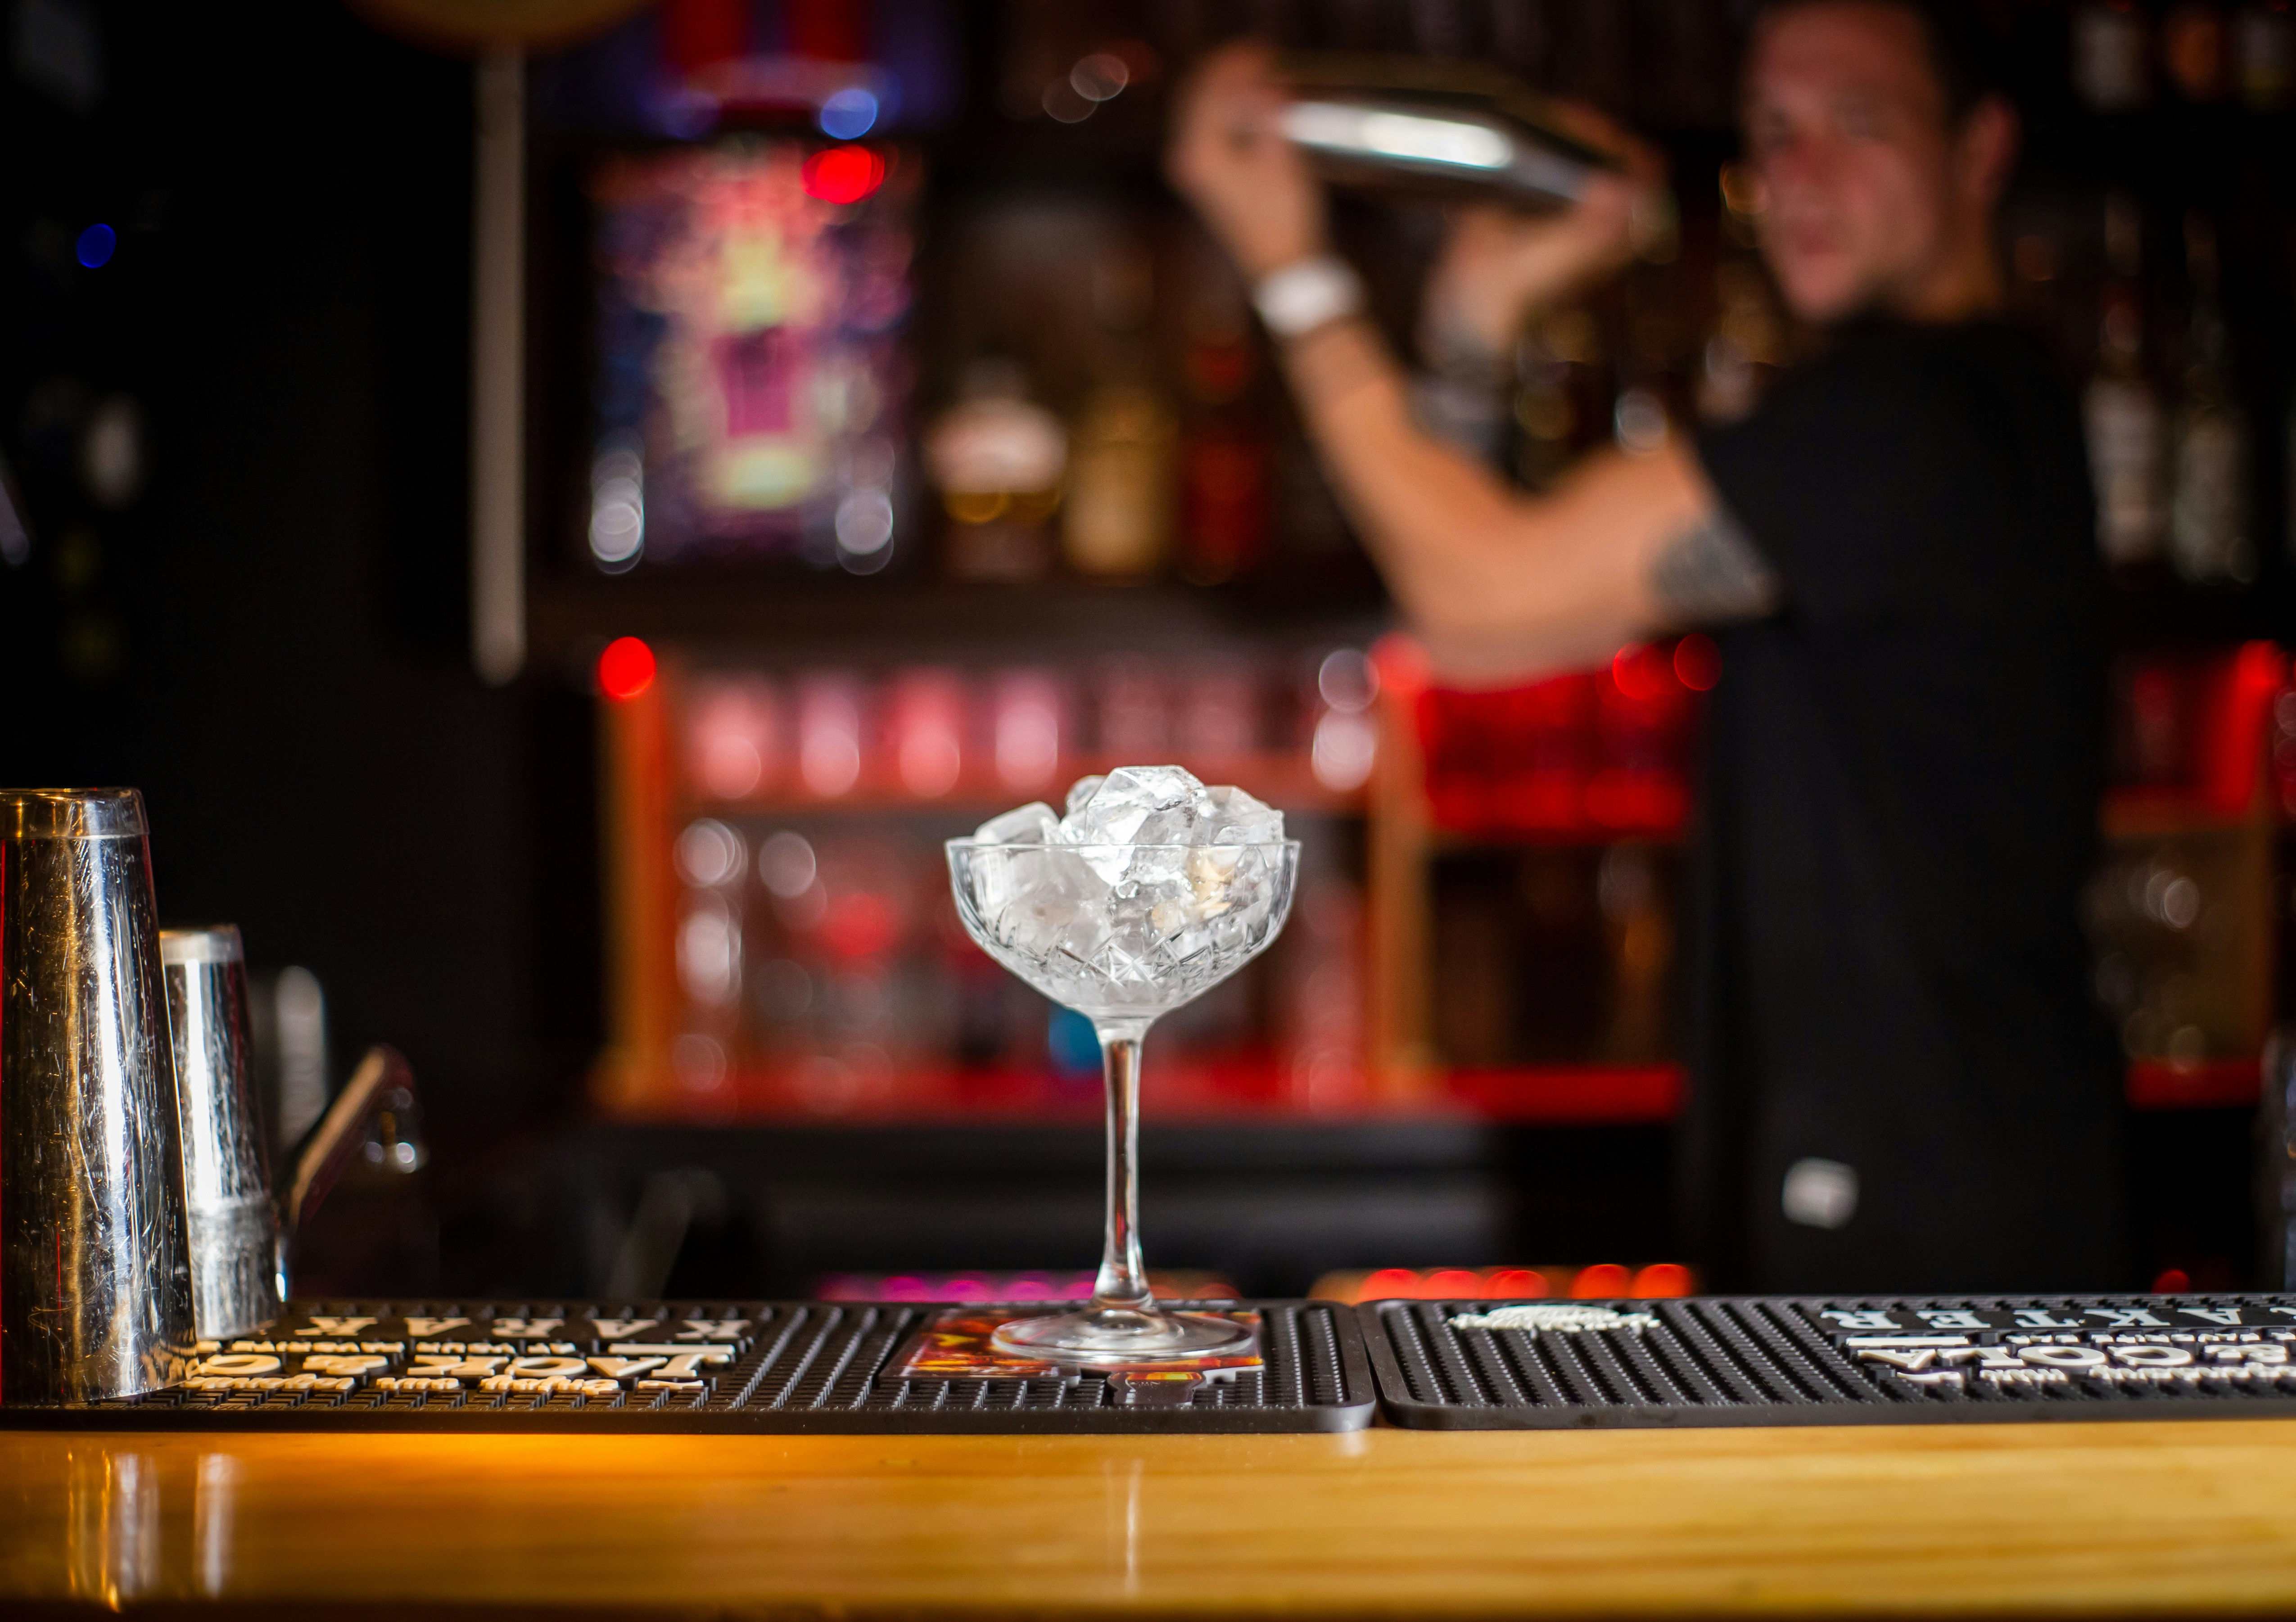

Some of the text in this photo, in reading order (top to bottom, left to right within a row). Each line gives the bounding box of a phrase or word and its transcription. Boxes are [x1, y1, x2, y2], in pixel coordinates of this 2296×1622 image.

[294, 1316, 753, 1340] KARAK
[1820, 1307, 2296, 1329] AKTER
[302, 1355, 389, 1375] &
[407, 1353, 731, 1378] JACK
[1857, 1344, 2287, 1370] & COLA
[479, 1374, 620, 1395] Enjoy
